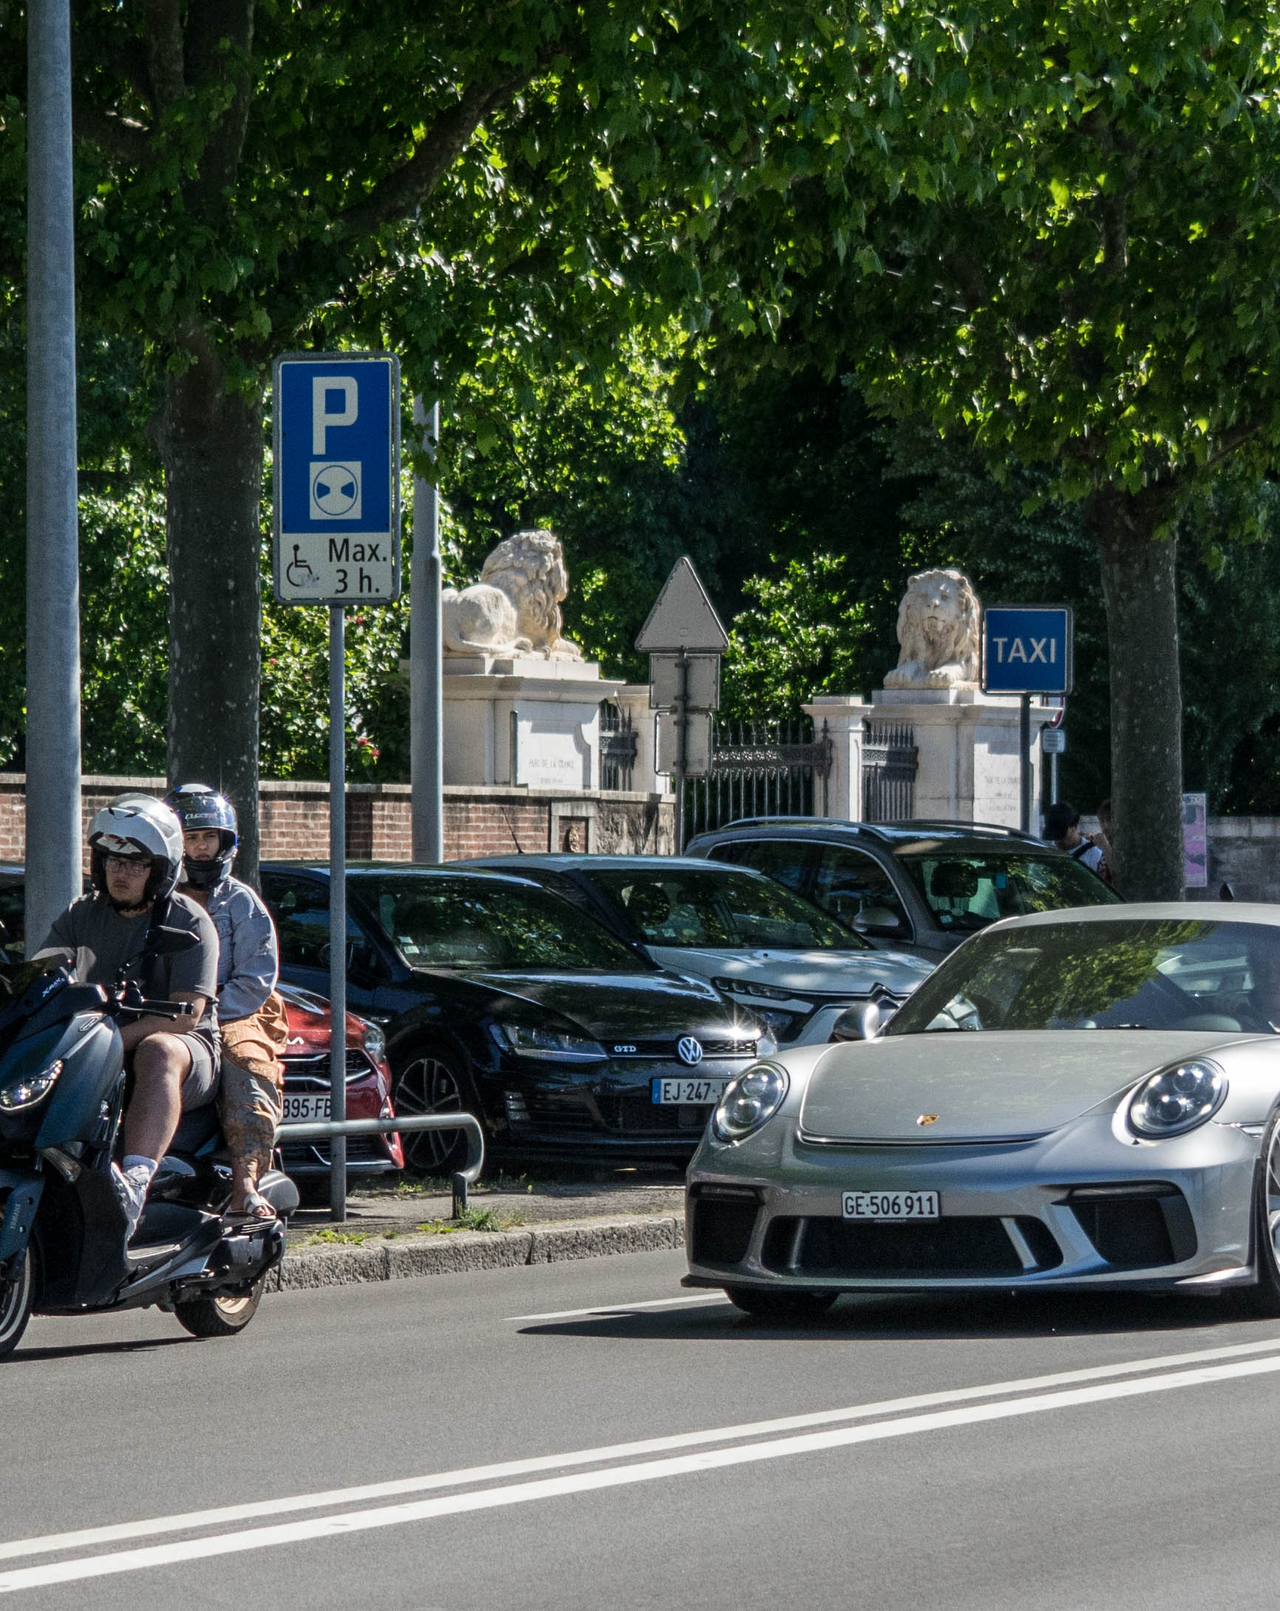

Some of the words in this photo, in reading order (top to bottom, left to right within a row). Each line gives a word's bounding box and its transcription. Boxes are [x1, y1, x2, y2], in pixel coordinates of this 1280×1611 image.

[312, 376, 358, 455] P
[328, 538, 388, 563] Max.
[335, 568, 348, 594] 3
[359, 567, 380, 593] h.
[992, 637, 1056, 664] TAXI
[614, 1045, 637, 1053] GTD
